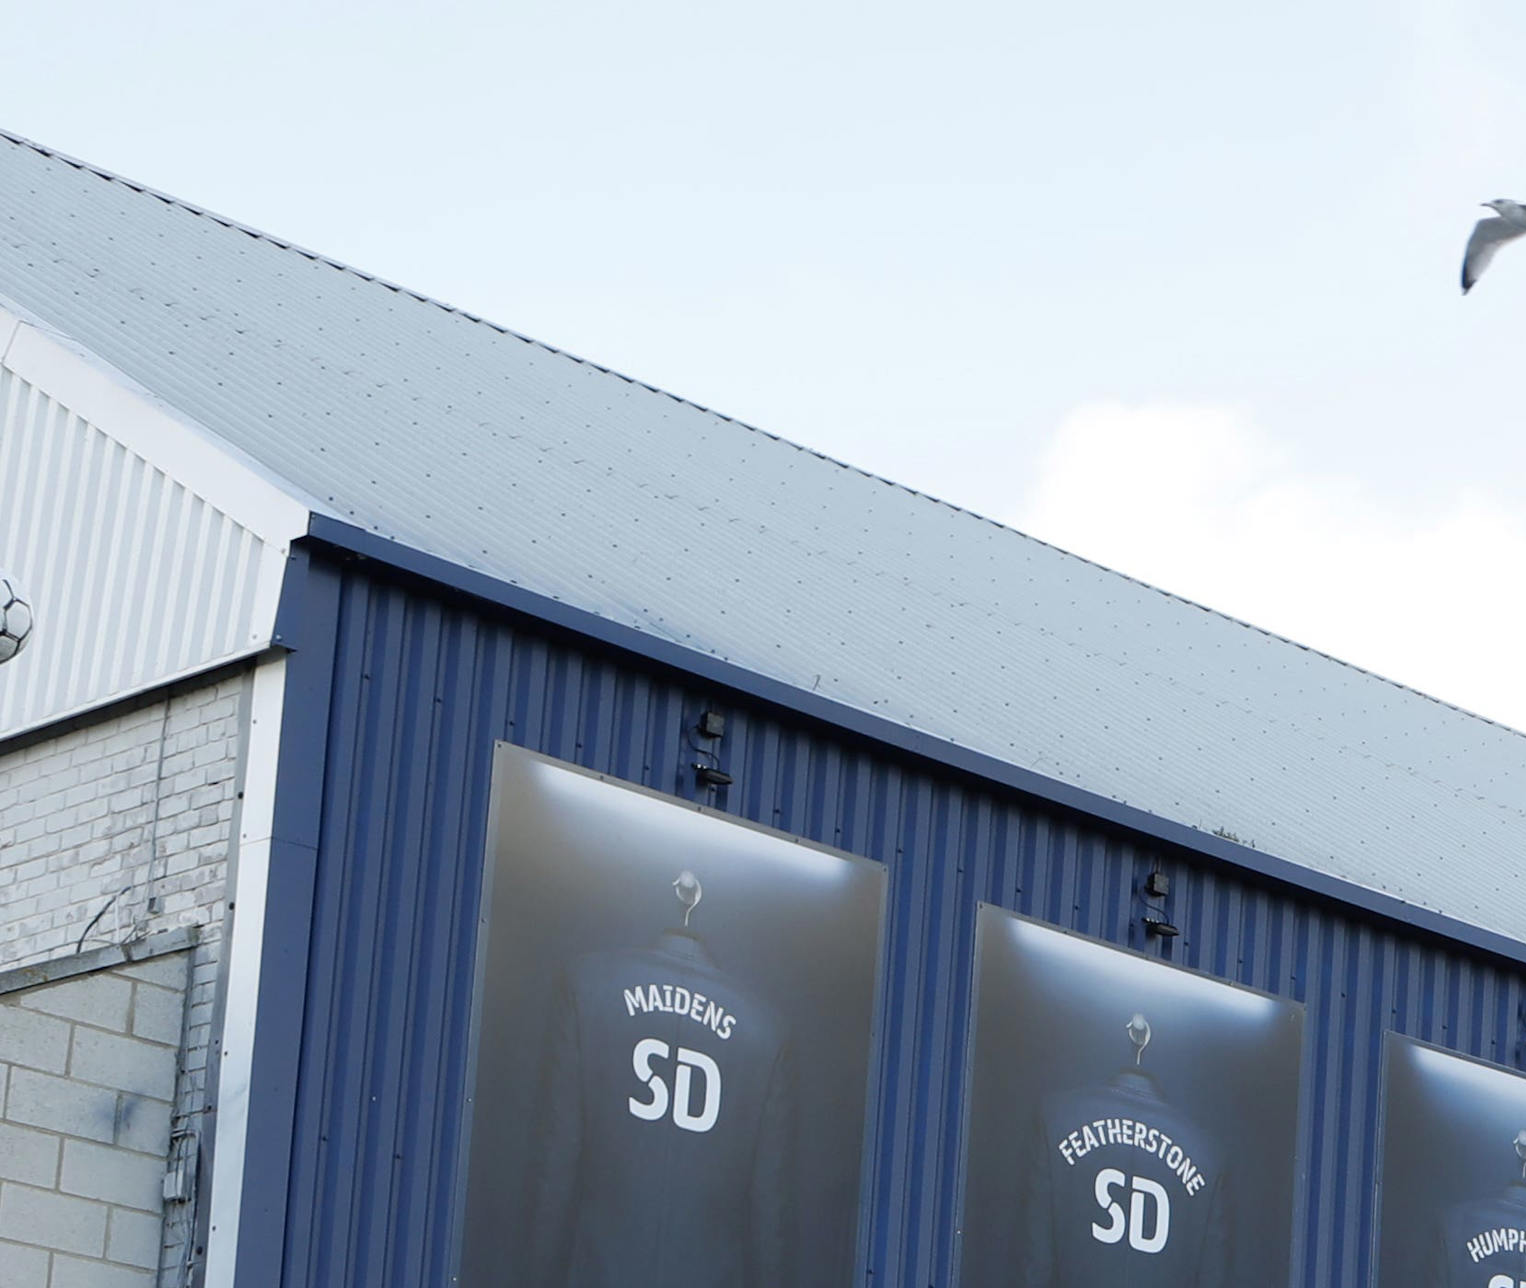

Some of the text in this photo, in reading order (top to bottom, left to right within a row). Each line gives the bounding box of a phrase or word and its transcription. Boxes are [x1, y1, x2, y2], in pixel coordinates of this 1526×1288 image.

[624, 984, 737, 1040] MAIDENS
[628, 1038, 722, 1132] SD
[1058, 1118, 1205, 1196] FEATHERSTONE
[1092, 1168, 1170, 1254] SD
